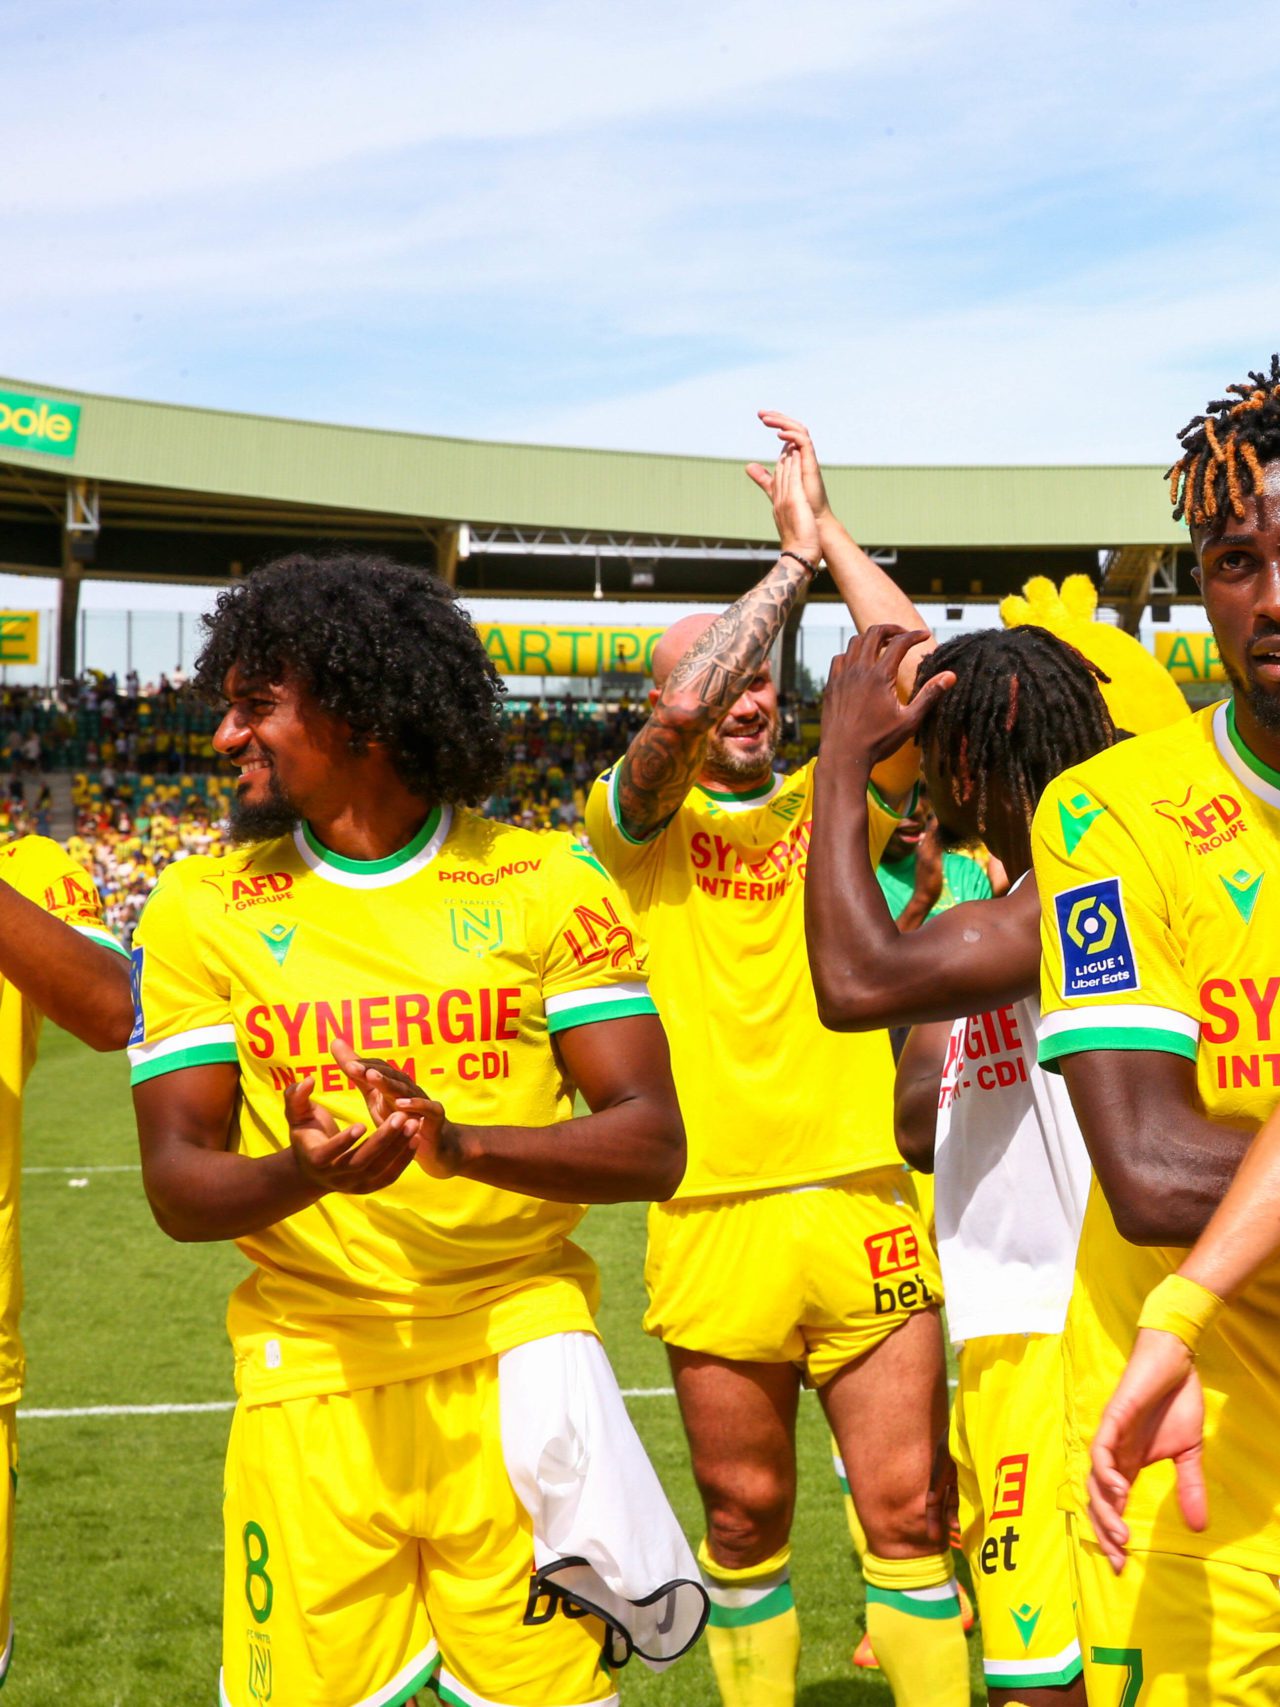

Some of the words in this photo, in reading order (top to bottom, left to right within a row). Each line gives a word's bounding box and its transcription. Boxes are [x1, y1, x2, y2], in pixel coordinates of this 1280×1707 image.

[1180, 794, 1242, 839] AFD
[232, 872, 294, 901] AFD
[235, 892, 295, 911] GROUPE
[1071, 978, 1100, 989] Uber
[1101, 970, 1130, 985] Eats
[1075, 957, 1116, 977] LIGUE
[1117, 954, 1125, 966] 1
[245, 988, 521, 1059] SYNERGIE
[457, 1050, 509, 1081] CDI
[976, 1056, 1027, 1090] CDI
[871, 1230, 917, 1272] ZE
[873, 1273, 933, 1315] bet
[981, 1526, 1020, 1575] et
[242, 1520, 274, 1624] 8
[1091, 1646, 1144, 1707] 7
